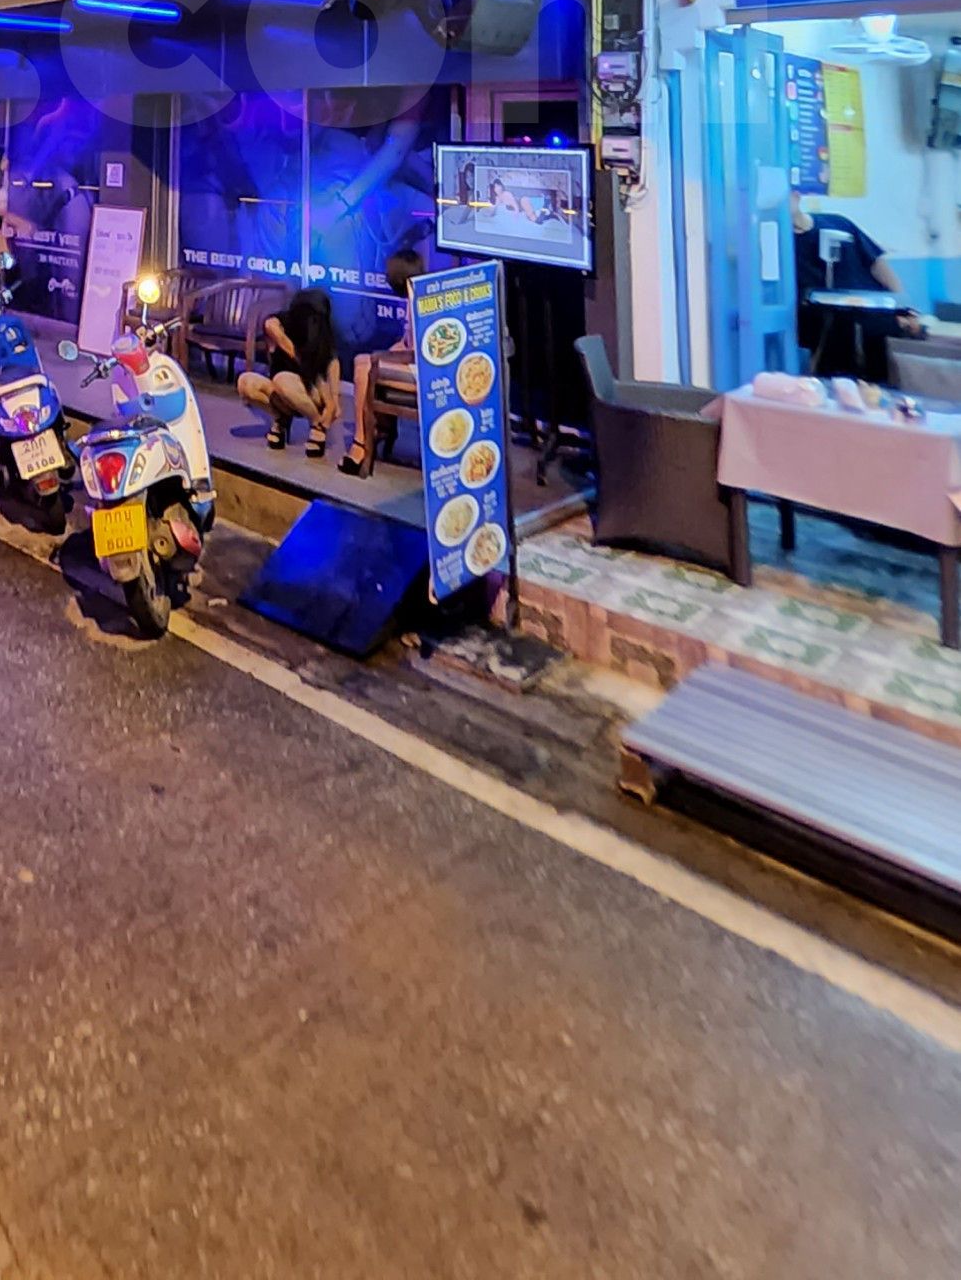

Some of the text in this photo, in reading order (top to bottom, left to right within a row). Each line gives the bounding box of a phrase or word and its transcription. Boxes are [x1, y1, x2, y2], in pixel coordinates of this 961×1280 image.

[183, 249, 207, 264] THE
[210, 252, 243, 269] BEST
[247, 257, 286, 275] GIRLS
[290, 261, 326, 281] AND
[331, 268, 360, 285] THE
